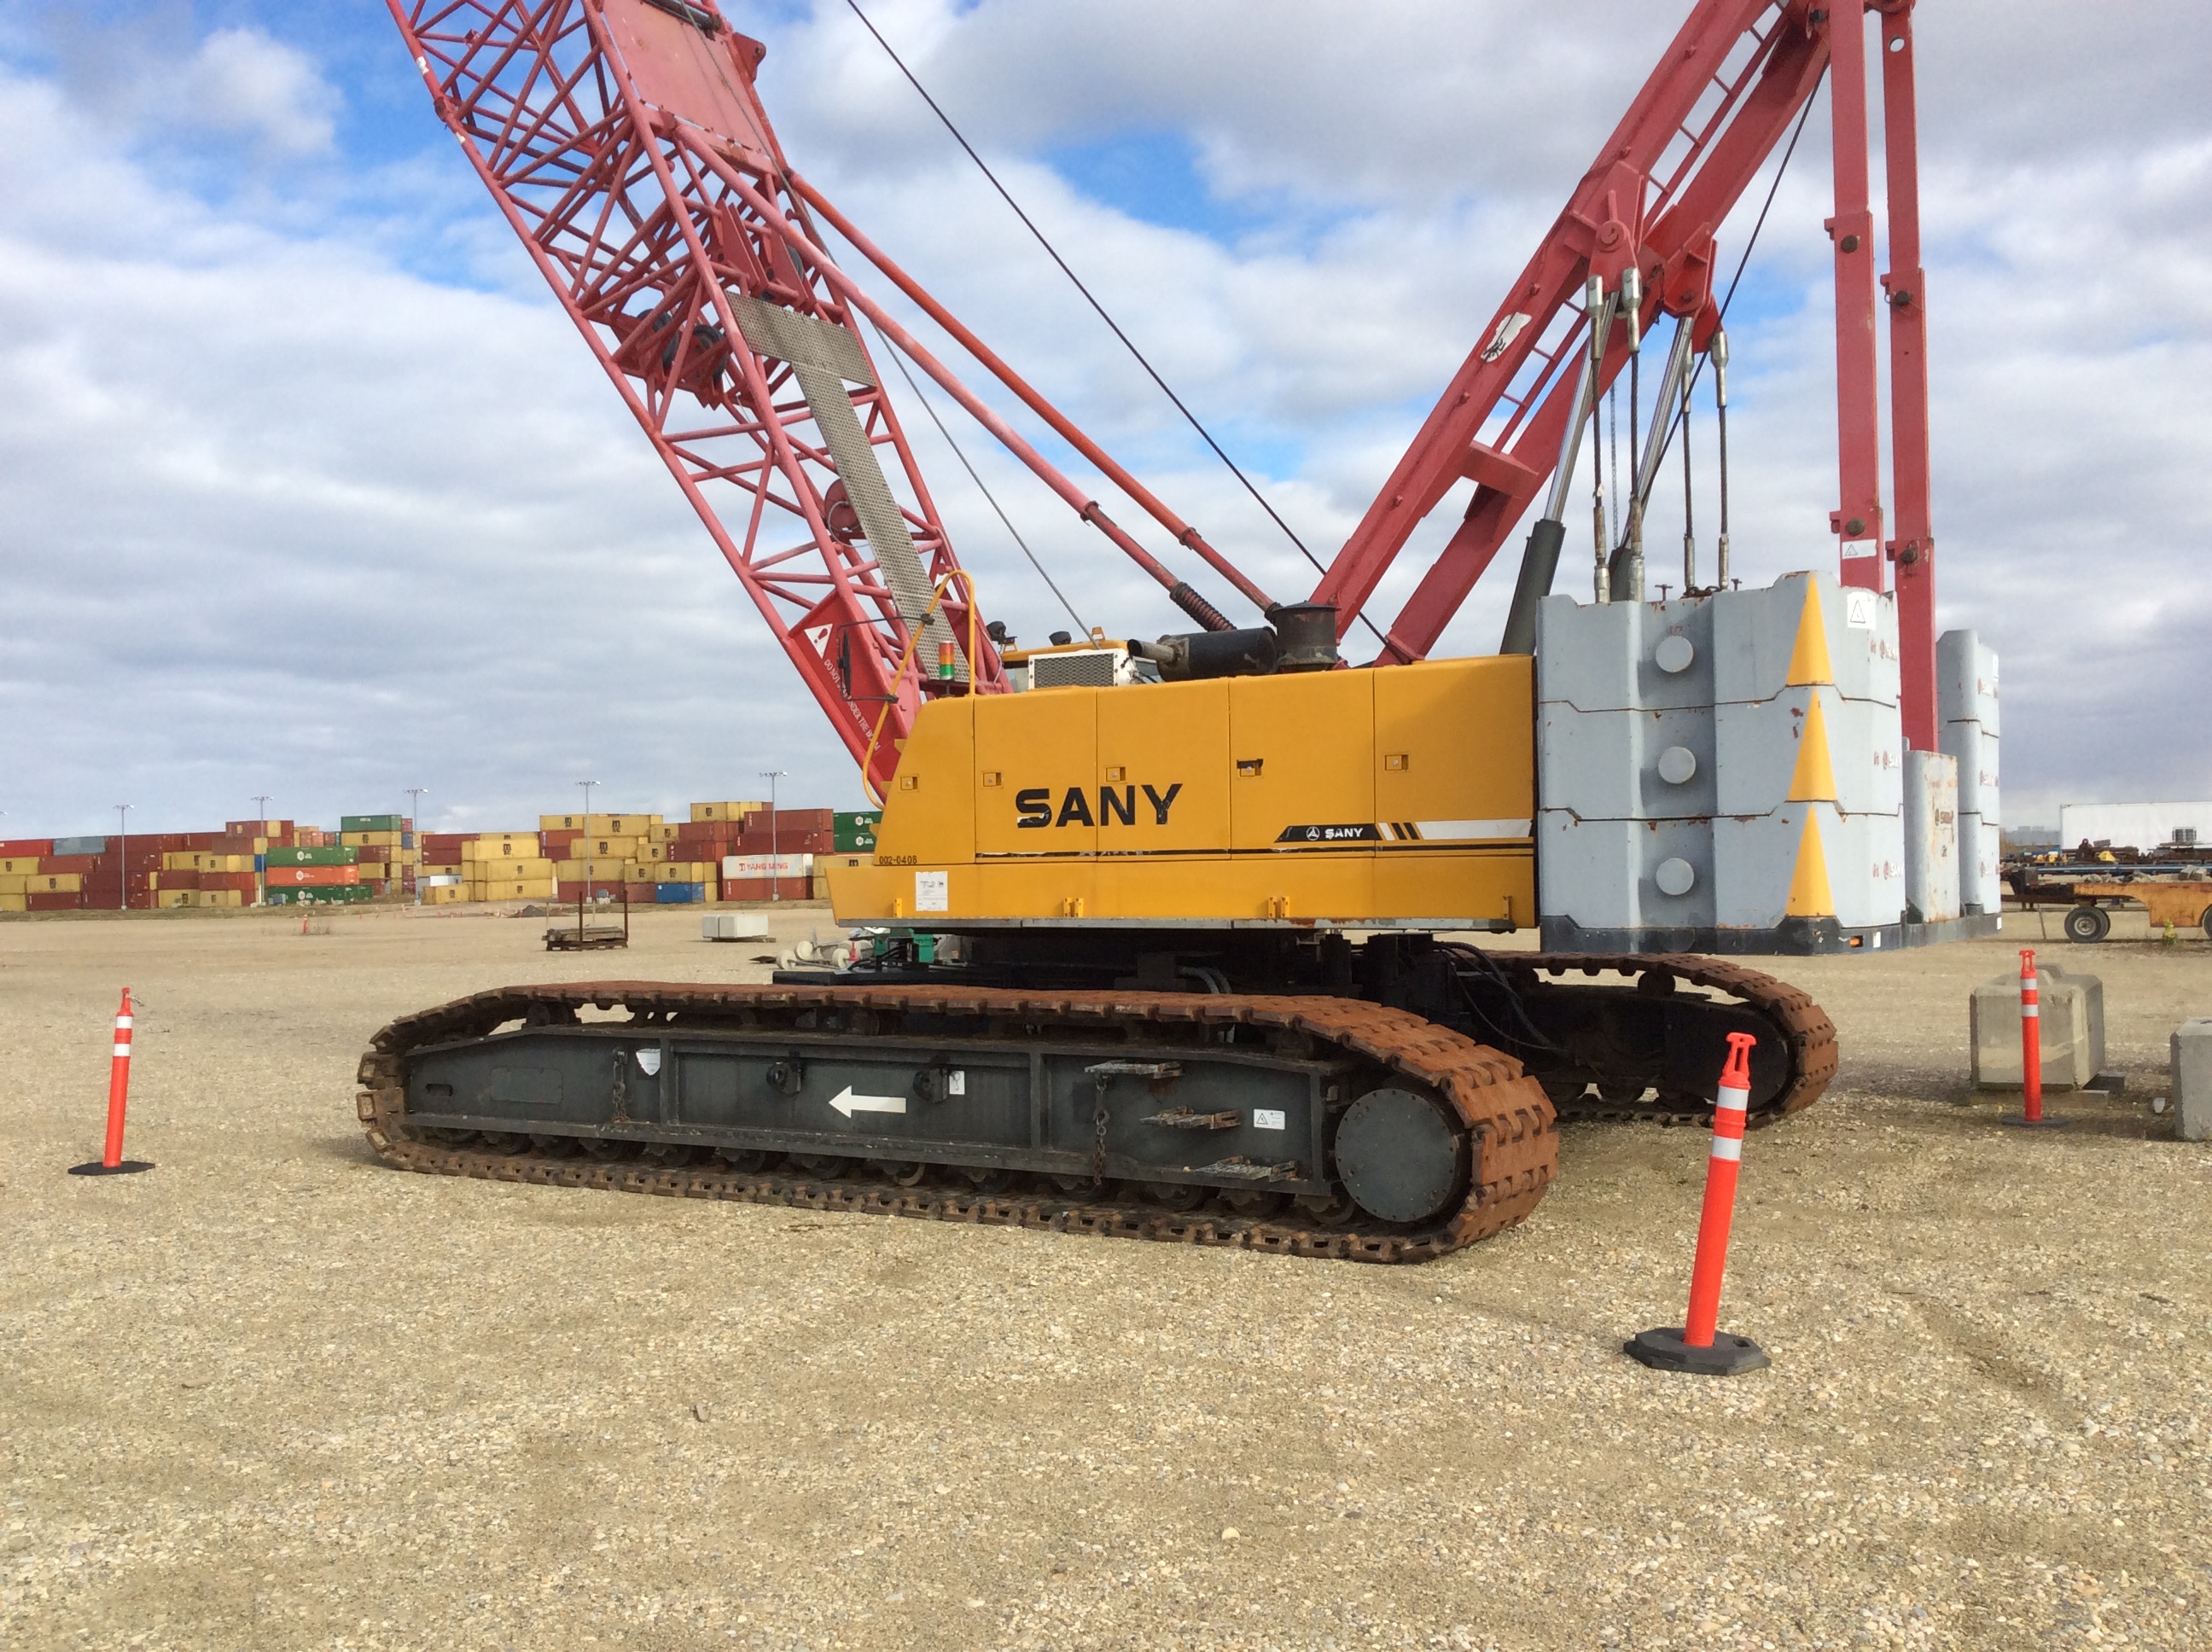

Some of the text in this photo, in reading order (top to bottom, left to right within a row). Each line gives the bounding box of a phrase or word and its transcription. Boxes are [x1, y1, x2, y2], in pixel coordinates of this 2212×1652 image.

[824, 659, 833, 671] DO
[830, 669, 841, 683] NOT
[859, 716, 870, 732] THE
[865, 729, 881, 751] BOM
[1016, 782, 1183, 829] SANY
[1324, 827, 1364, 840] SANY
[879, 855, 917, 865] 002-0408
